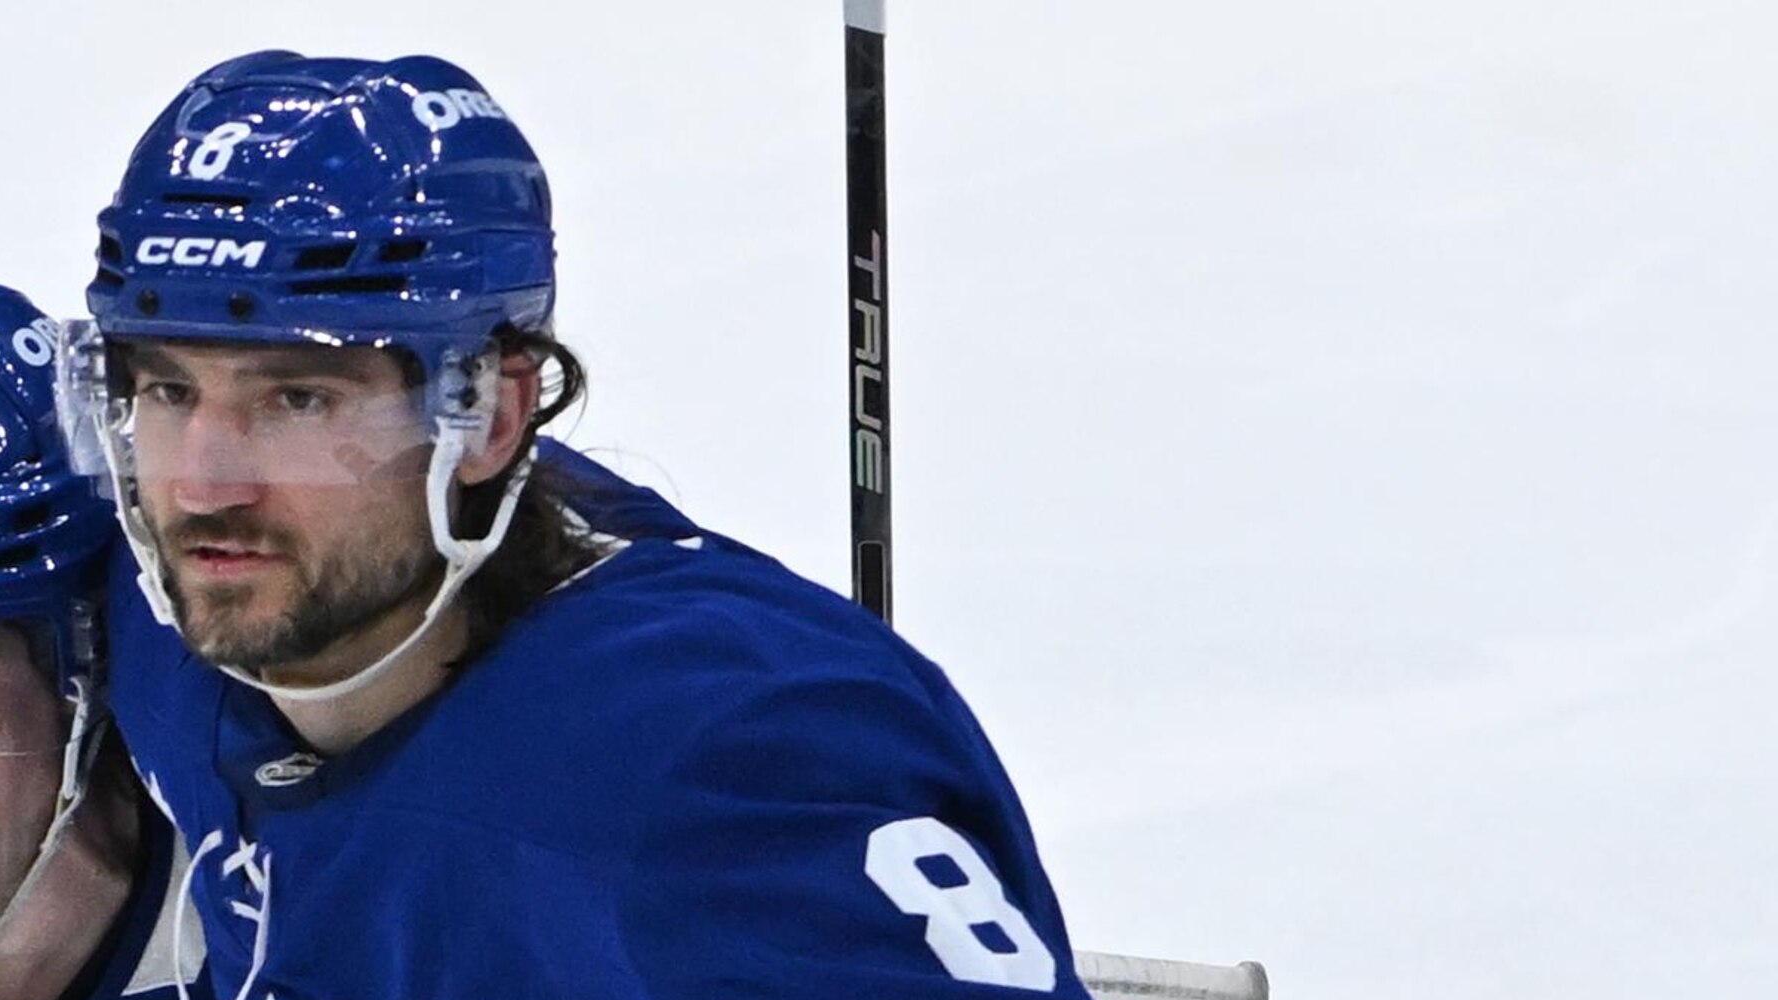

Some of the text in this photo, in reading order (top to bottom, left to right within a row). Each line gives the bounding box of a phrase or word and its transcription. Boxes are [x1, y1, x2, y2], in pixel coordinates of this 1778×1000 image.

[188, 121, 252, 181] 8
[135, 236, 269, 269] CCM
[853, 229, 884, 495] TRUE
[865, 816, 1057, 994] 8
